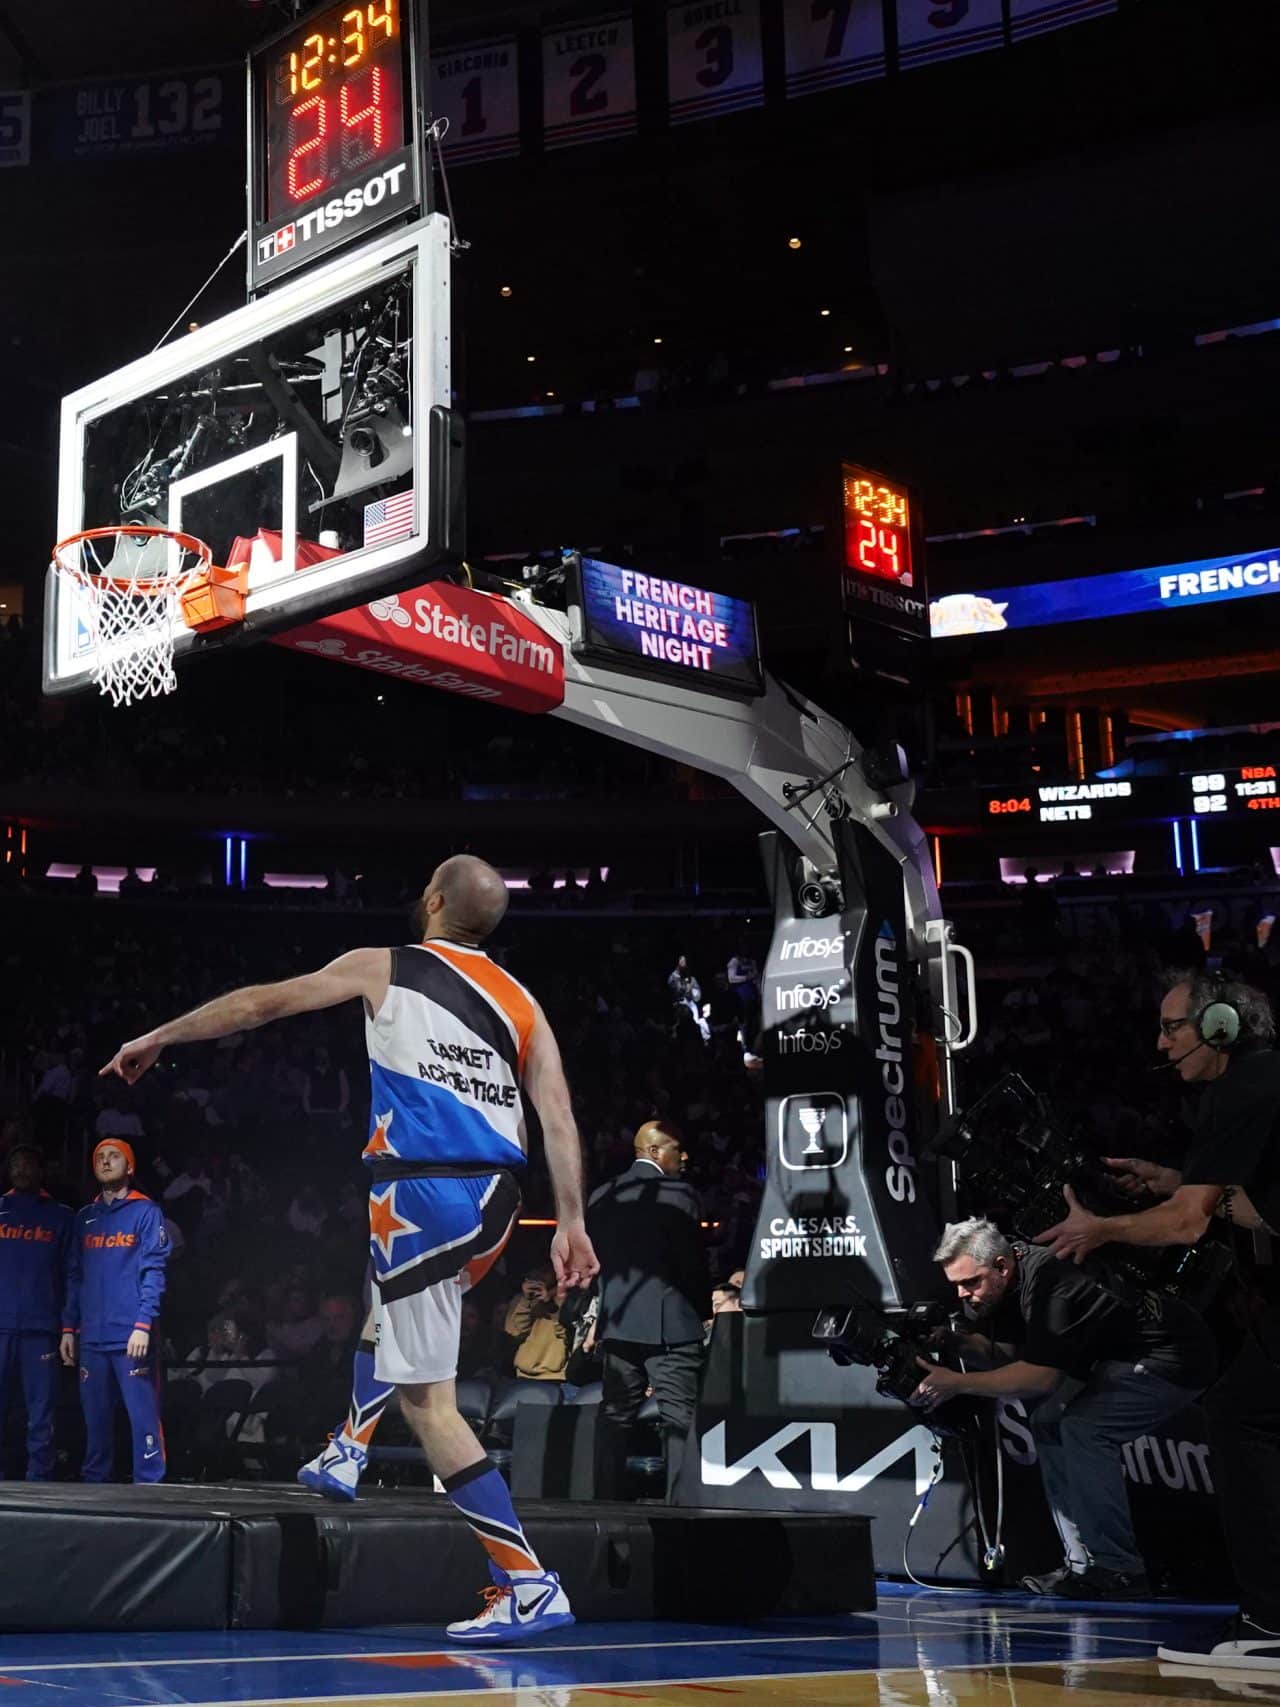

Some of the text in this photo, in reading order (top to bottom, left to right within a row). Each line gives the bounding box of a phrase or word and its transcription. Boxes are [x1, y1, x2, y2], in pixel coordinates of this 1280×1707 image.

[290, 0, 393, 94] 12:34
[696, 26, 733, 87] 3
[130, 77, 224, 137] 132
[461, 77, 486, 136] 1
[570, 53, 608, 115] 2
[289, 66, 382, 200] 24
[296, 162, 407, 242] TISSOT
[859, 519, 899, 574] 24
[621, 569, 713, 617] FRENCH
[615, 596, 728, 648] HERITAGE
[641, 630, 713, 671] NIGHT
[1038, 781, 1132, 802] WIZARDS
[1241, 766, 1278, 781] NBA
[988, 797, 1032, 814] 8:04
[1039, 804, 1093, 823] NETS
[1246, 796, 1280, 811] 4TH
[779, 935, 846, 961] Infosys
[776, 983, 841, 1011] Infosys
[777, 1029, 843, 1055] Infosys
[874, 937, 917, 1204] Spectrum
[83, 1231, 138, 1249] Knicks
[760, 1234, 868, 1260] SPORTSBOOK
[701, 1419, 945, 1497] KIA
